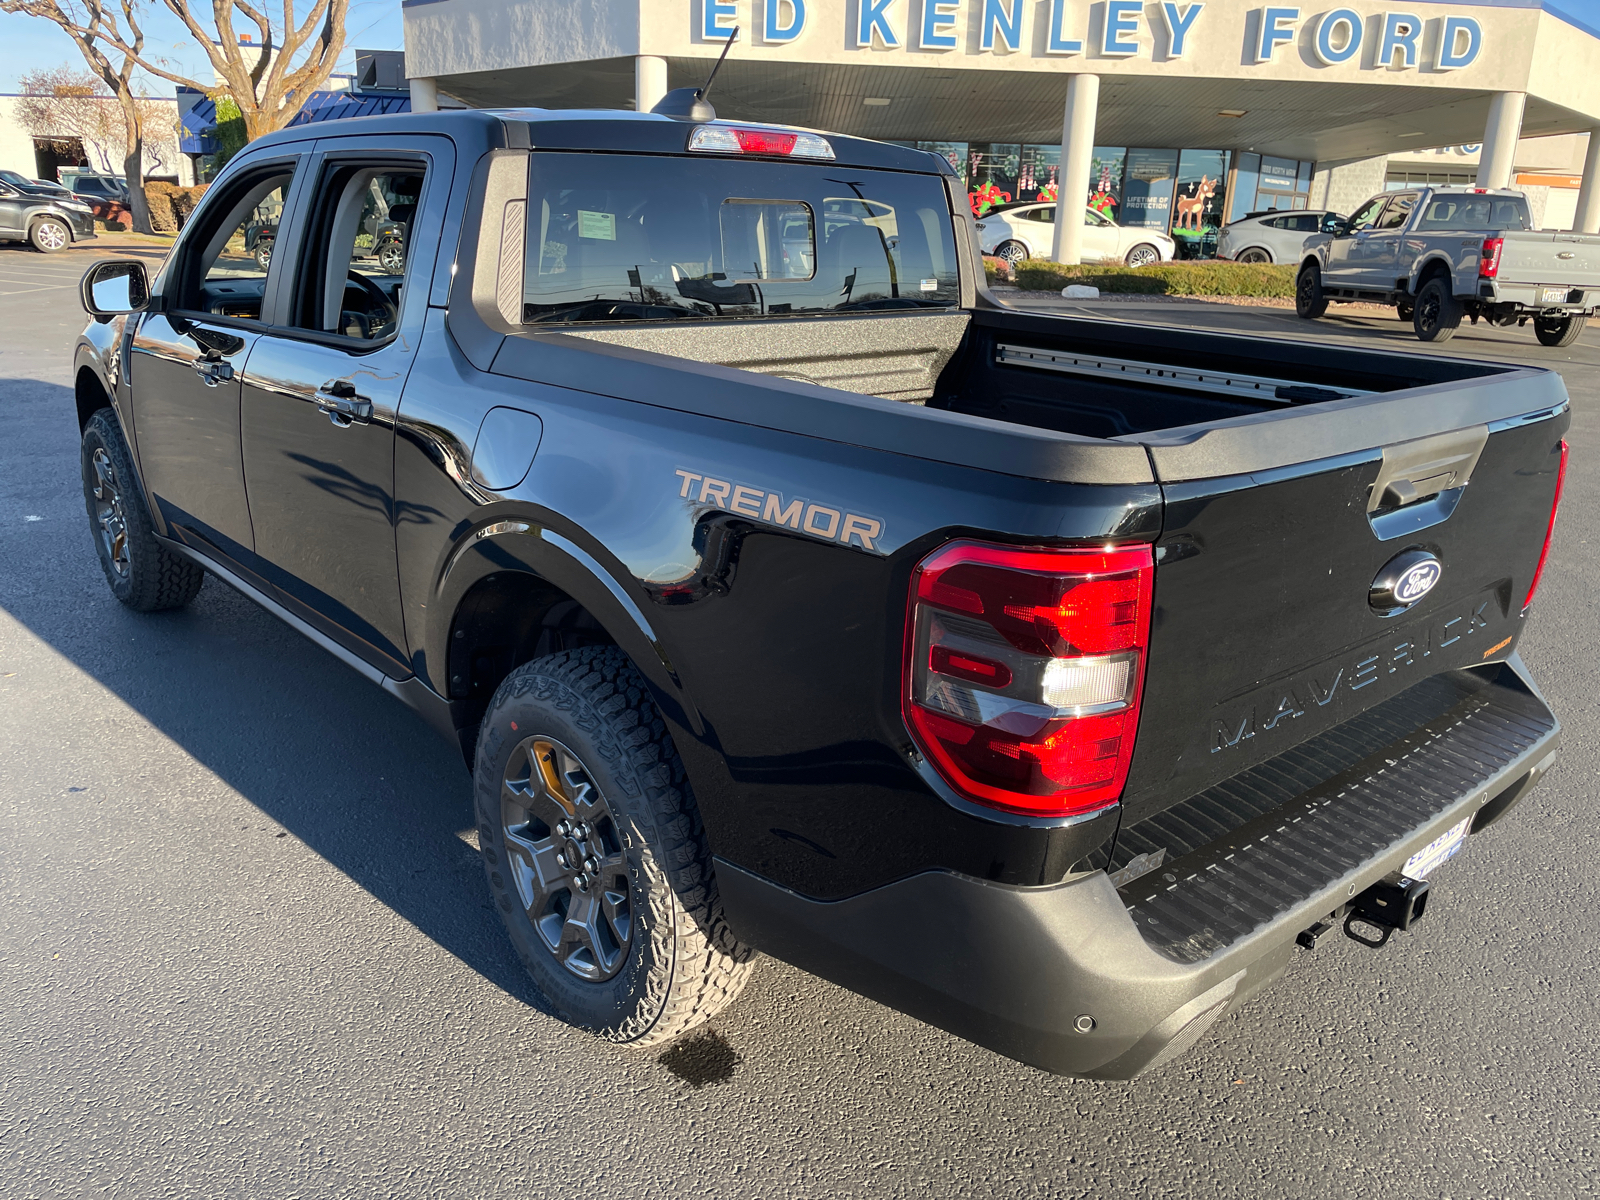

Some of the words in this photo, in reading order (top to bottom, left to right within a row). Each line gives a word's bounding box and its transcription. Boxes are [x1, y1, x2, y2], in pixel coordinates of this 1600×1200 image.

[701, 0, 807, 43] ED
[857, 0, 1206, 58] KENLEY
[1255, 6, 1484, 70] FORD
[674, 467, 883, 552] TREMOR
[1402, 566, 1435, 598] Ford
[1210, 601, 1489, 754] MAVERICK
[1482, 635, 1512, 659] TREMOR
